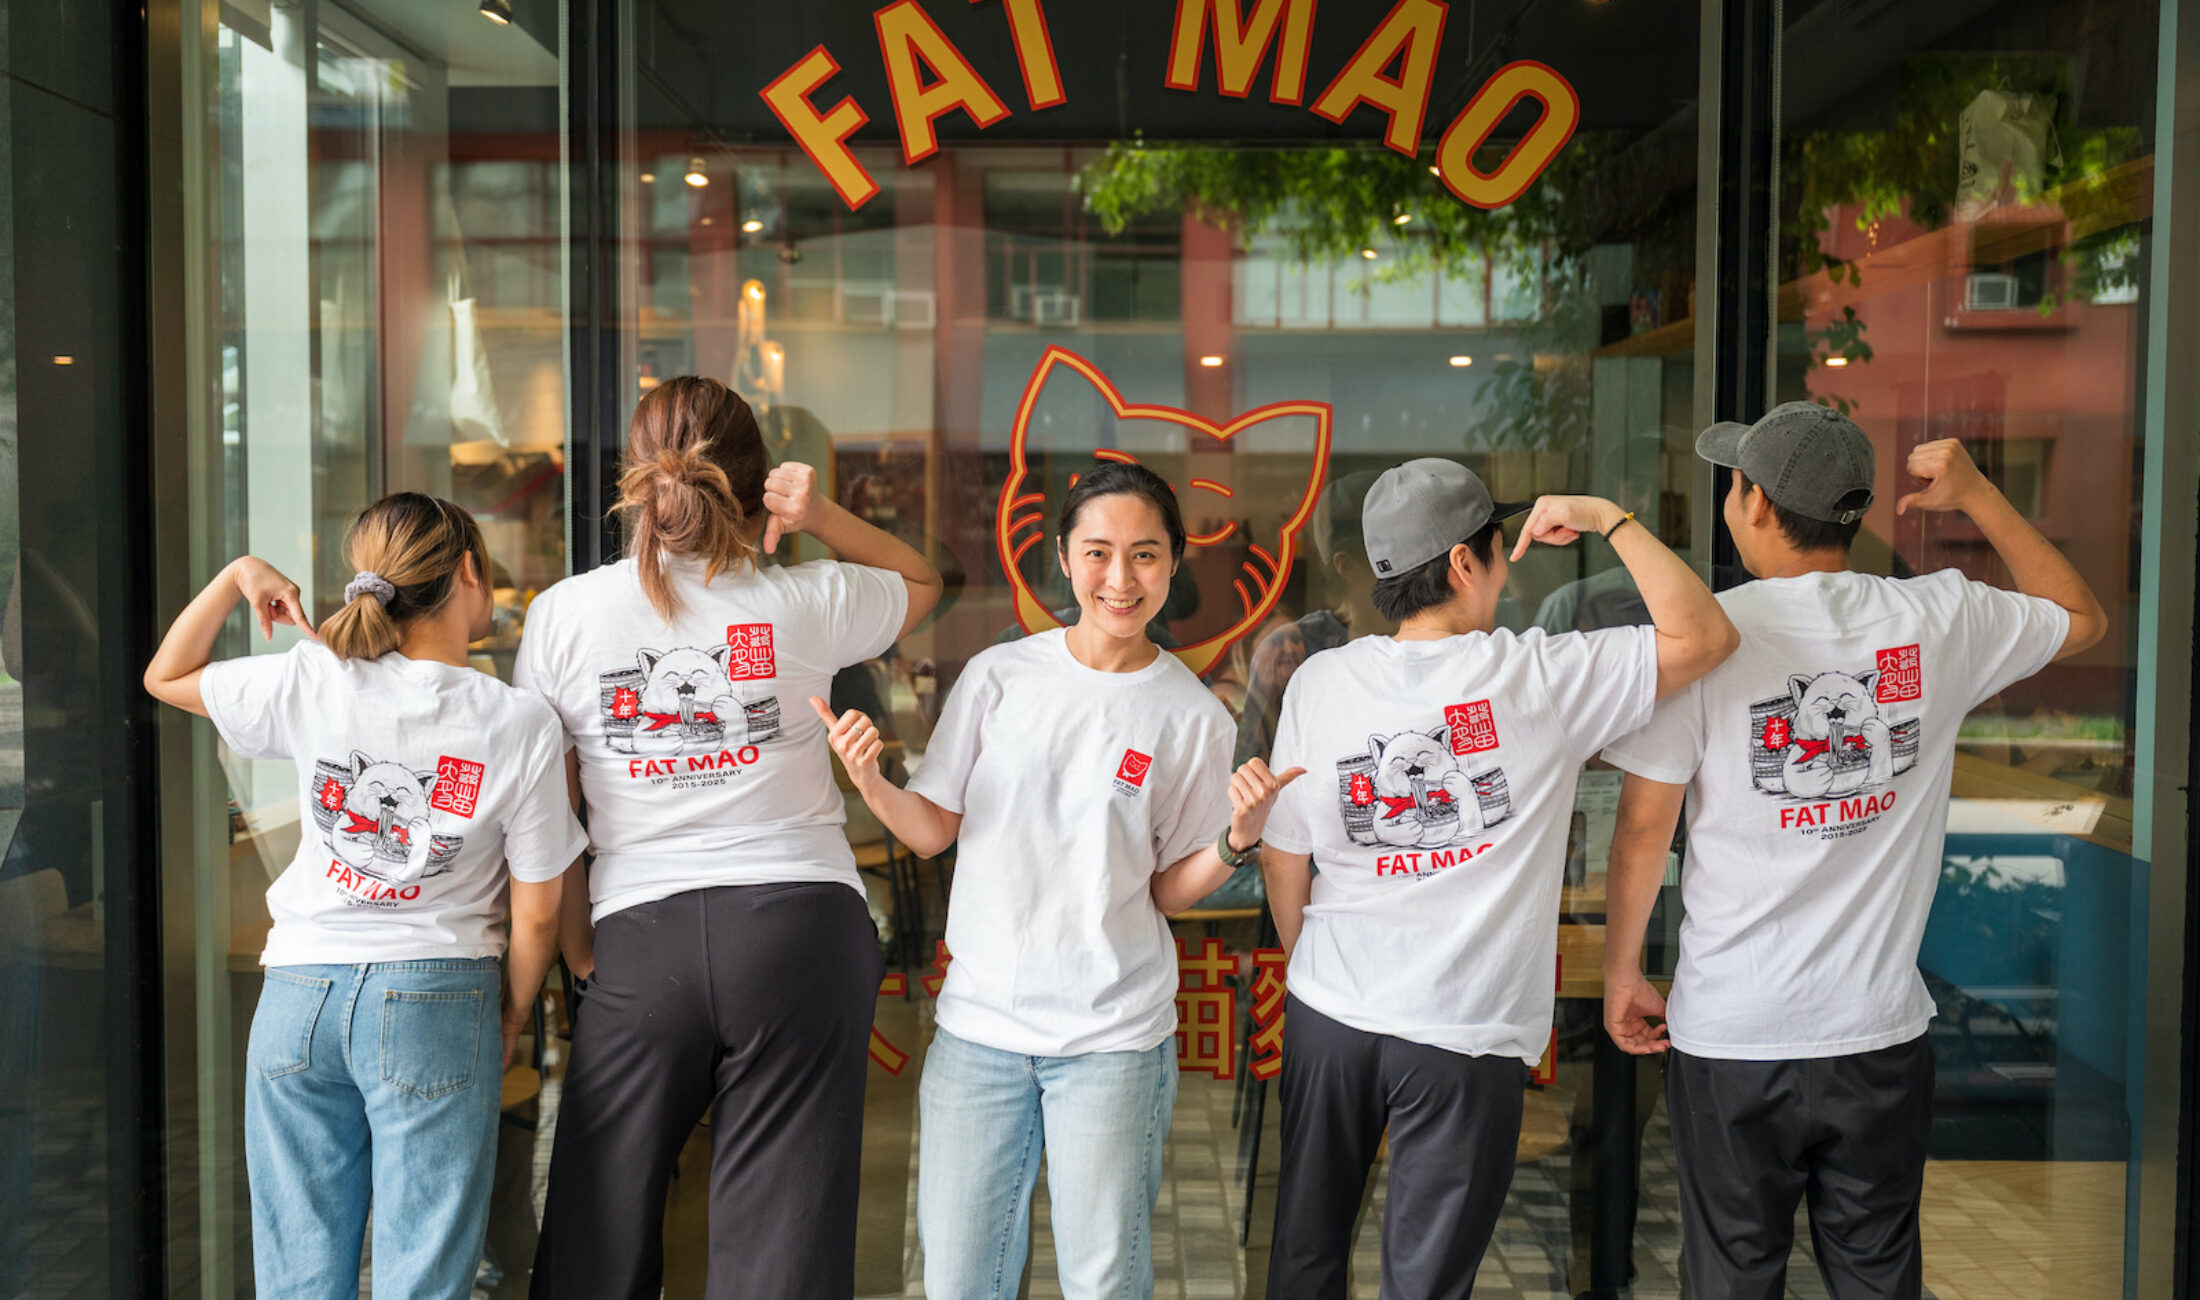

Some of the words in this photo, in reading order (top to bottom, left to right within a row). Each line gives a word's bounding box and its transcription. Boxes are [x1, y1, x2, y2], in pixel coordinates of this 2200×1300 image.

[1164, 0, 1580, 209] MAO
[619, 690, 633, 717] 十年
[1770, 719, 1784, 747] 十年
[629, 759, 677, 778] FAT
[688, 745, 759, 771] MAO
[672, 769, 742, 782] ANNIVERSARY
[672, 778, 727, 789] 2015-2025
[1354, 776, 1369, 804] 十年
[1781, 803, 1831, 829] FAT
[1840, 791, 1896, 821] MAO
[1821, 815, 1881, 833] ANNIVERSARY
[1821, 826, 1867, 840] 2015-2025
[326, 859, 366, 892] FAT
[1377, 853, 1422, 876] FAT
